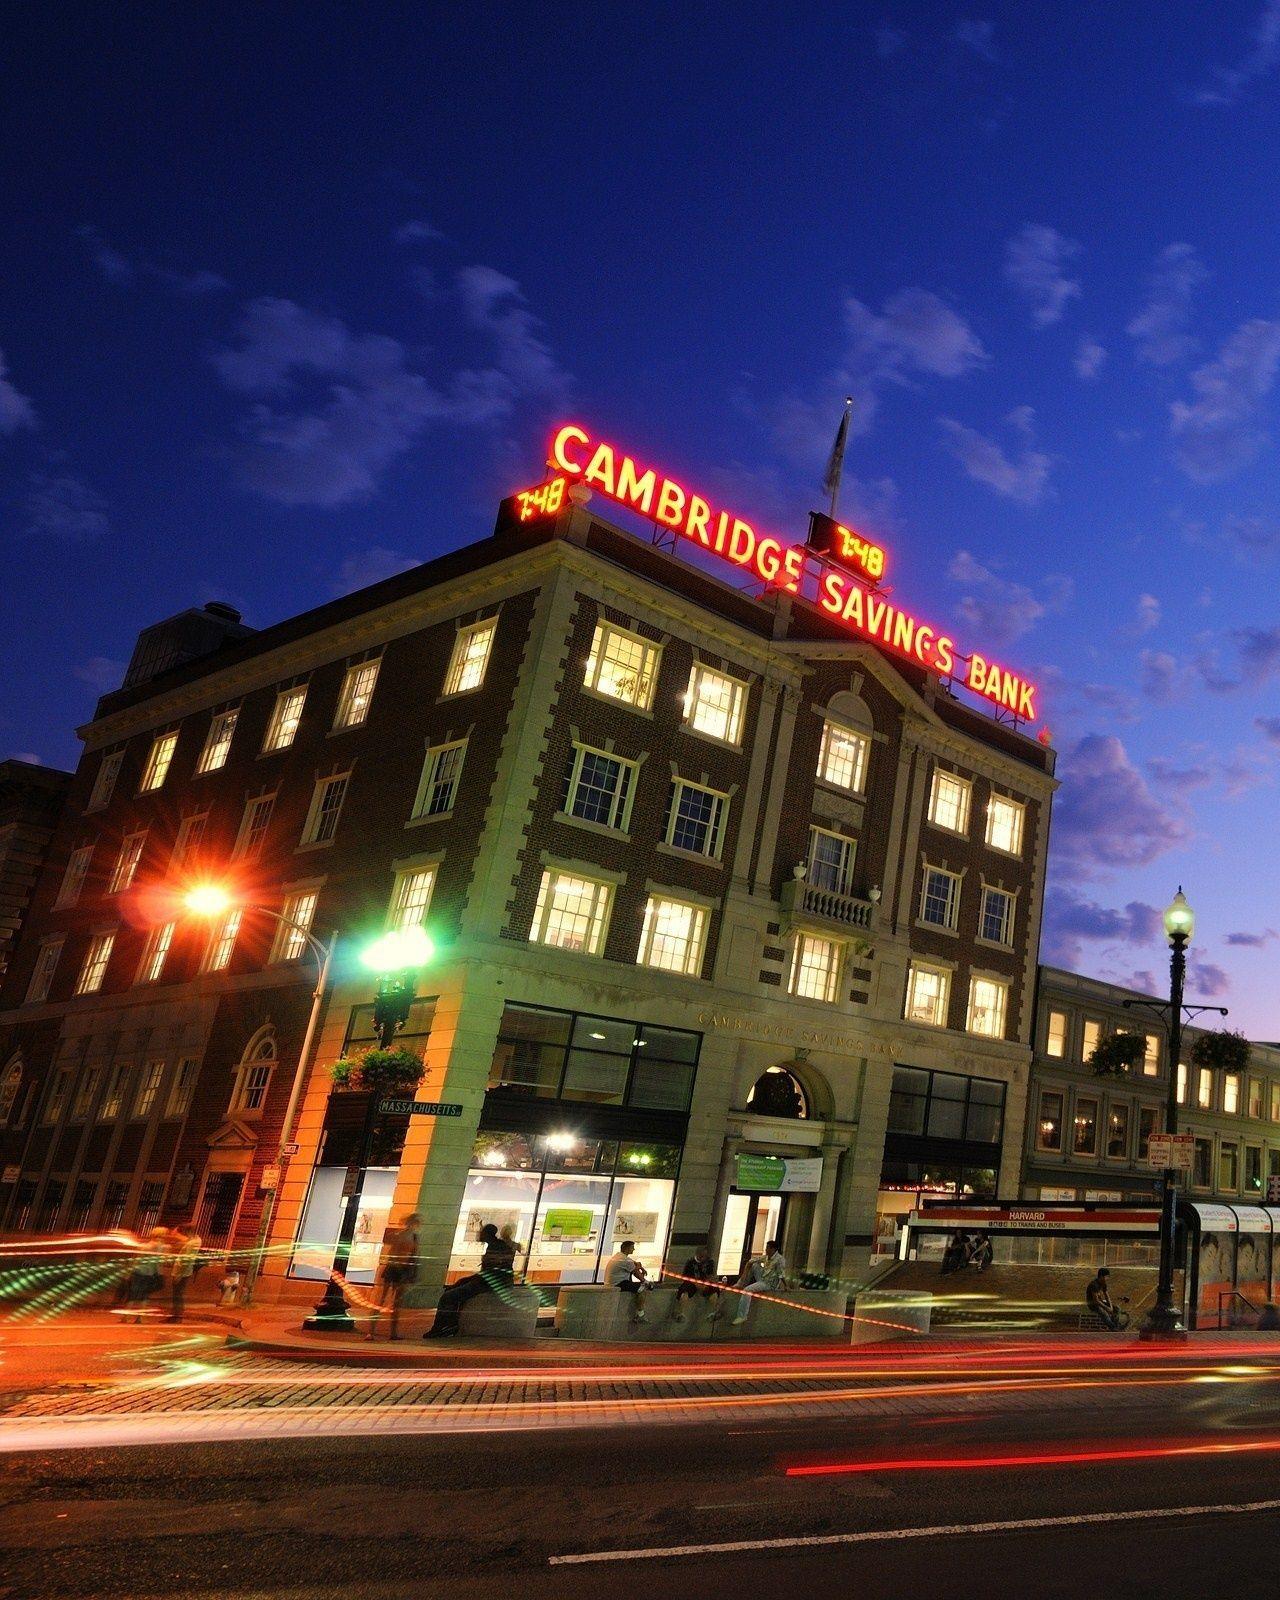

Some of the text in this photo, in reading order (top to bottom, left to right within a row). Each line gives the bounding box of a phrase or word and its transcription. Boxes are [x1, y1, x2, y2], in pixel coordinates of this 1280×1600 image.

[517, 477, 567, 522] 7:48
[554, 426, 1036, 720] CAMBRIDGE SAVINGS BANK
[837, 525, 885, 577] 7:48
[381, 1101, 458, 1116] MASSACHUSETTS
[1009, 1211, 1045, 1221] HARVARD
